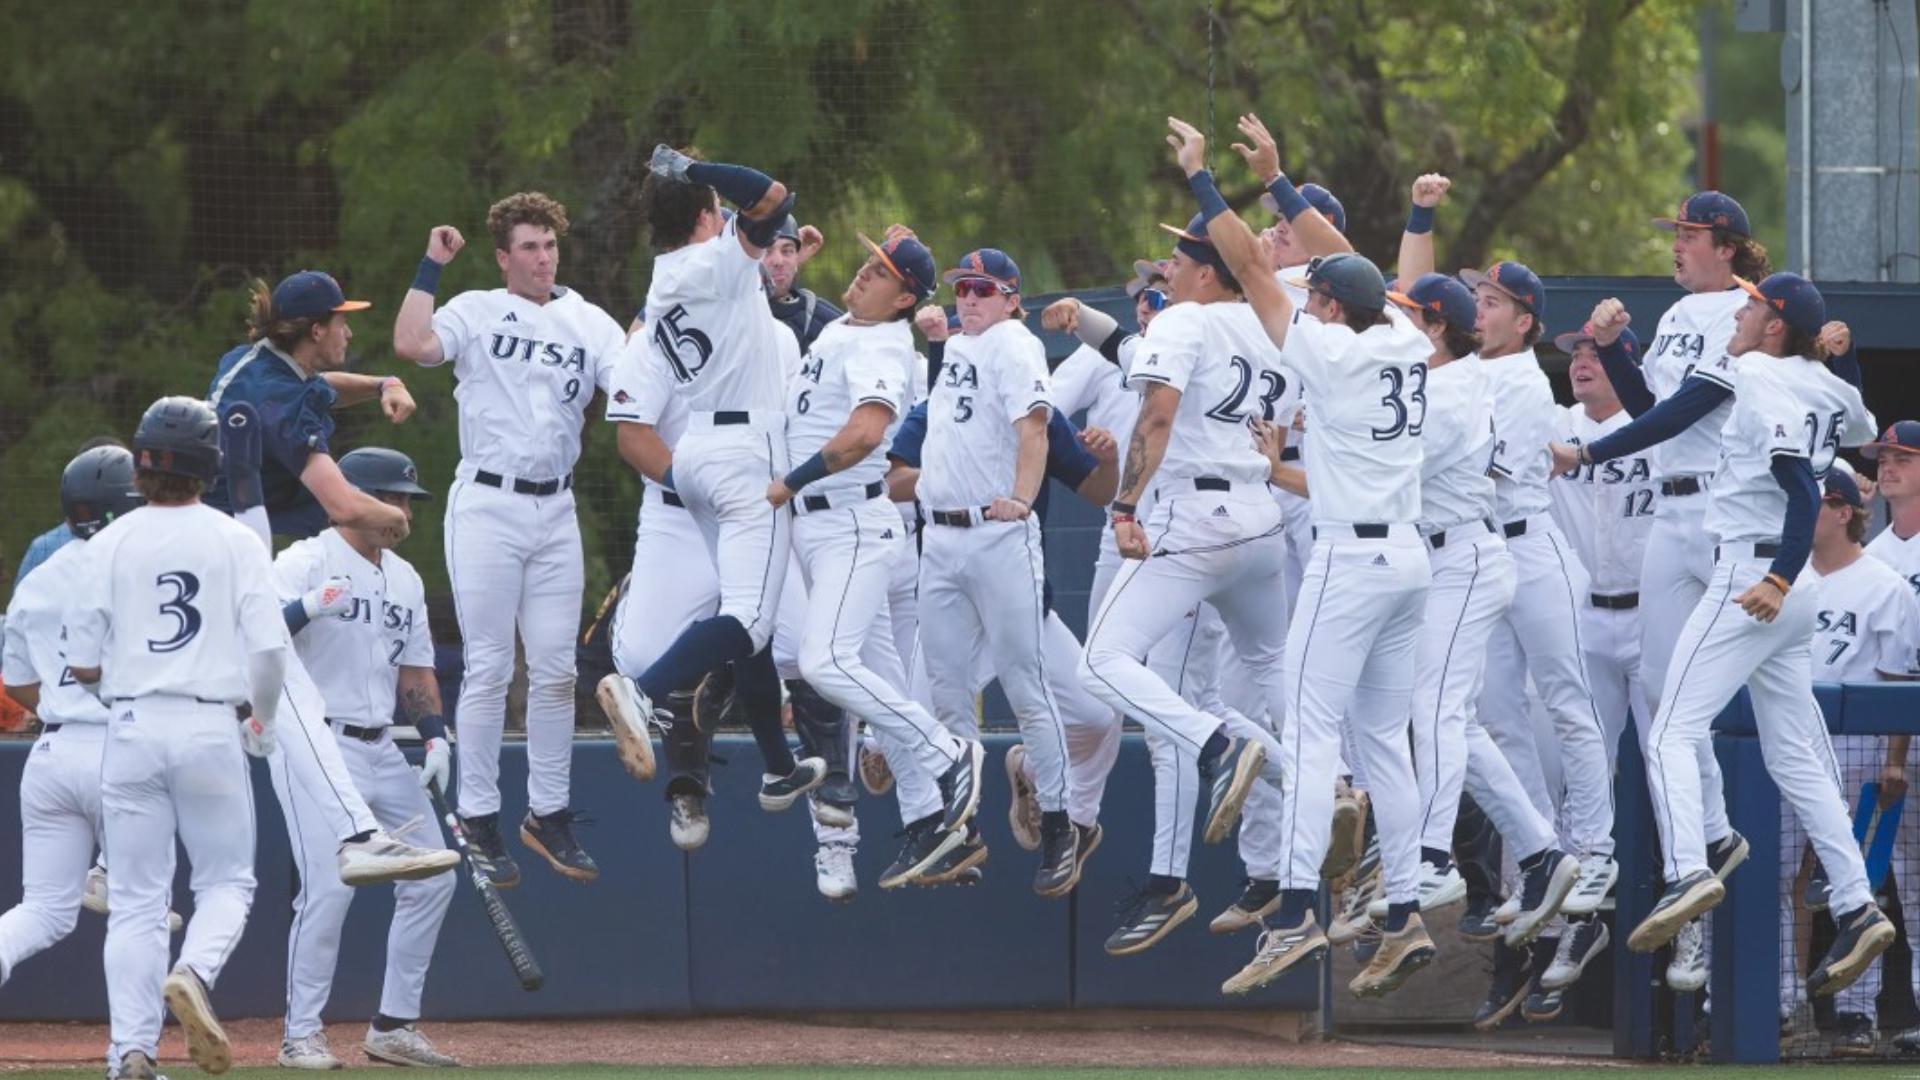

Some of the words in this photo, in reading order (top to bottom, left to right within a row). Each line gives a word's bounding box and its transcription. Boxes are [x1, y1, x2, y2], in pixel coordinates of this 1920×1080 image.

[490, 333, 586, 374] UTSA
[654, 303, 713, 384] 15
[942, 362, 979, 390] SA
[560, 378, 581, 404] 9
[797, 389, 812, 415] 6
[1204, 355, 1287, 436] 23
[1372, 362, 1428, 441] 33
[954, 396, 974, 424] 5
[1623, 489, 1655, 518] 12
[147, 570, 203, 653] 3
[1815, 609, 1857, 637] SA
[388, 639, 405, 668] 2
[1825, 639, 1851, 666] 7
